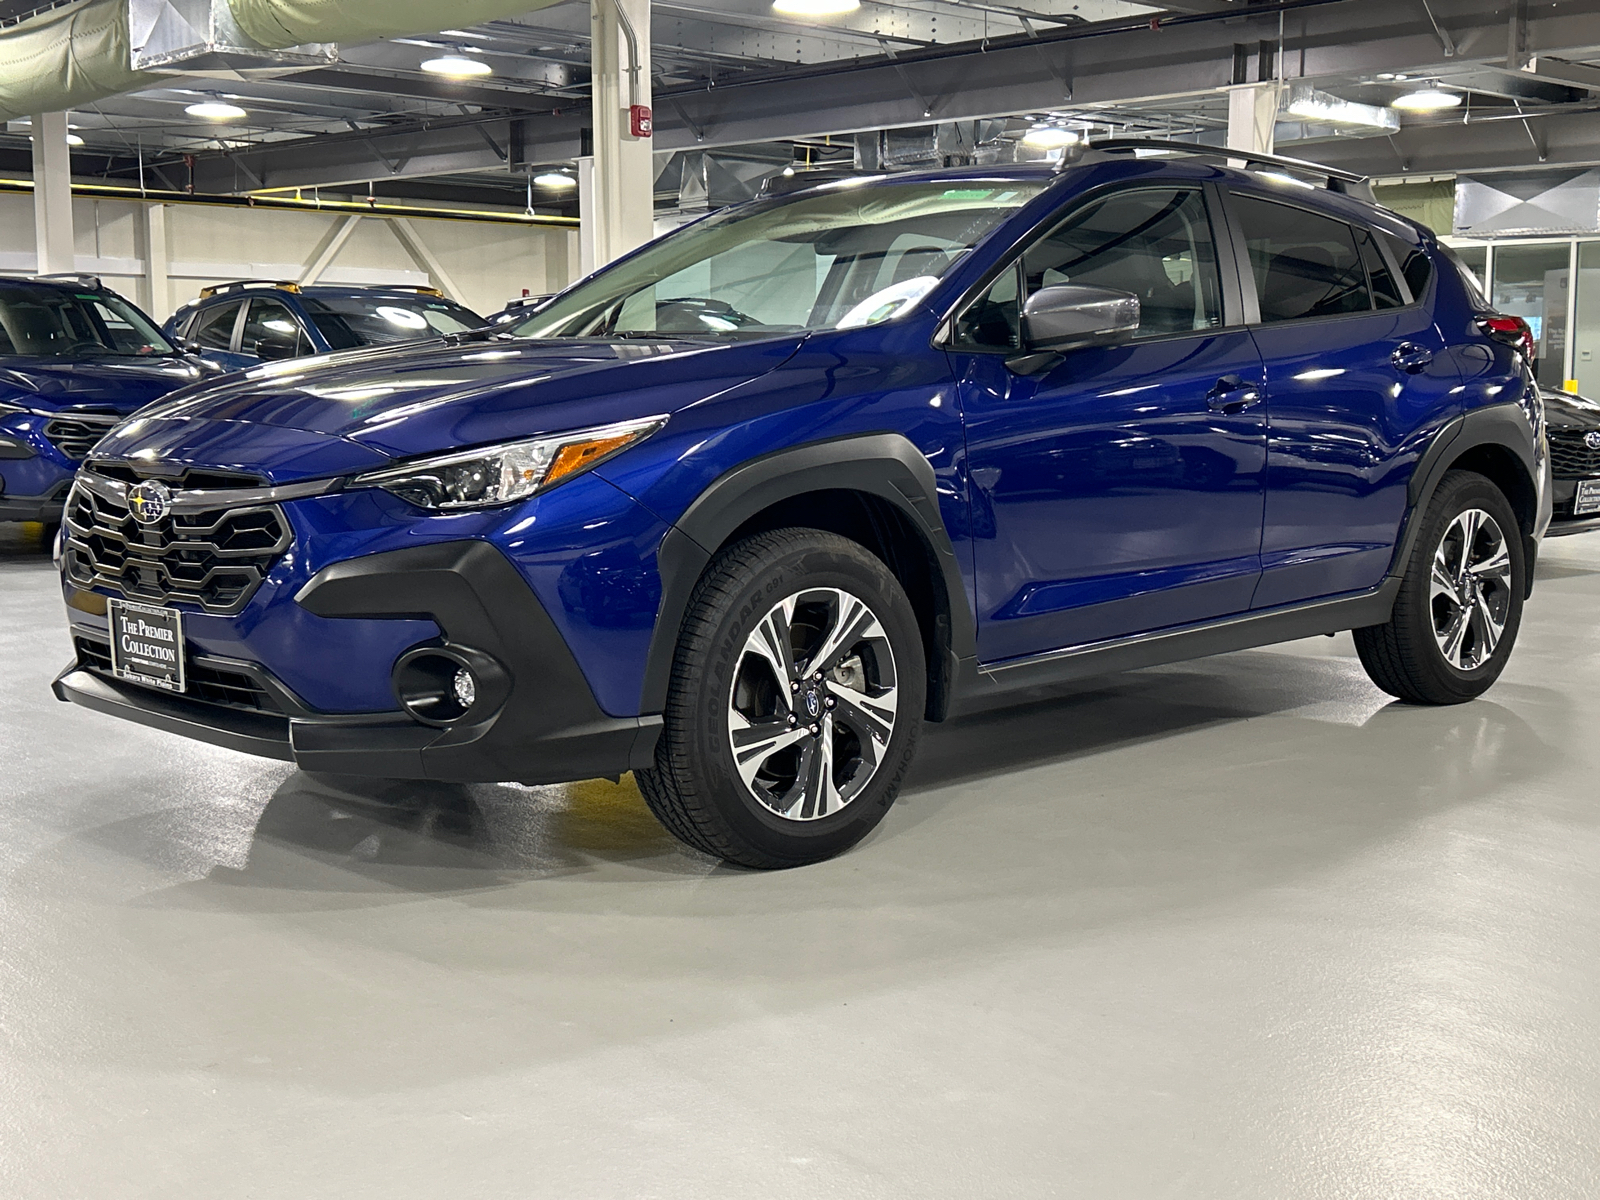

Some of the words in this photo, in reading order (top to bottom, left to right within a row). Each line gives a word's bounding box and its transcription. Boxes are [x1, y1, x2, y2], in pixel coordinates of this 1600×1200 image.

[120, 616, 138, 635] THE
[137, 619, 174, 642] PREMIER
[122, 635, 175, 662] COLLECTION
[707, 589, 763, 753] GEOLANDAR
[876, 717, 919, 807] YOKOHAMA
